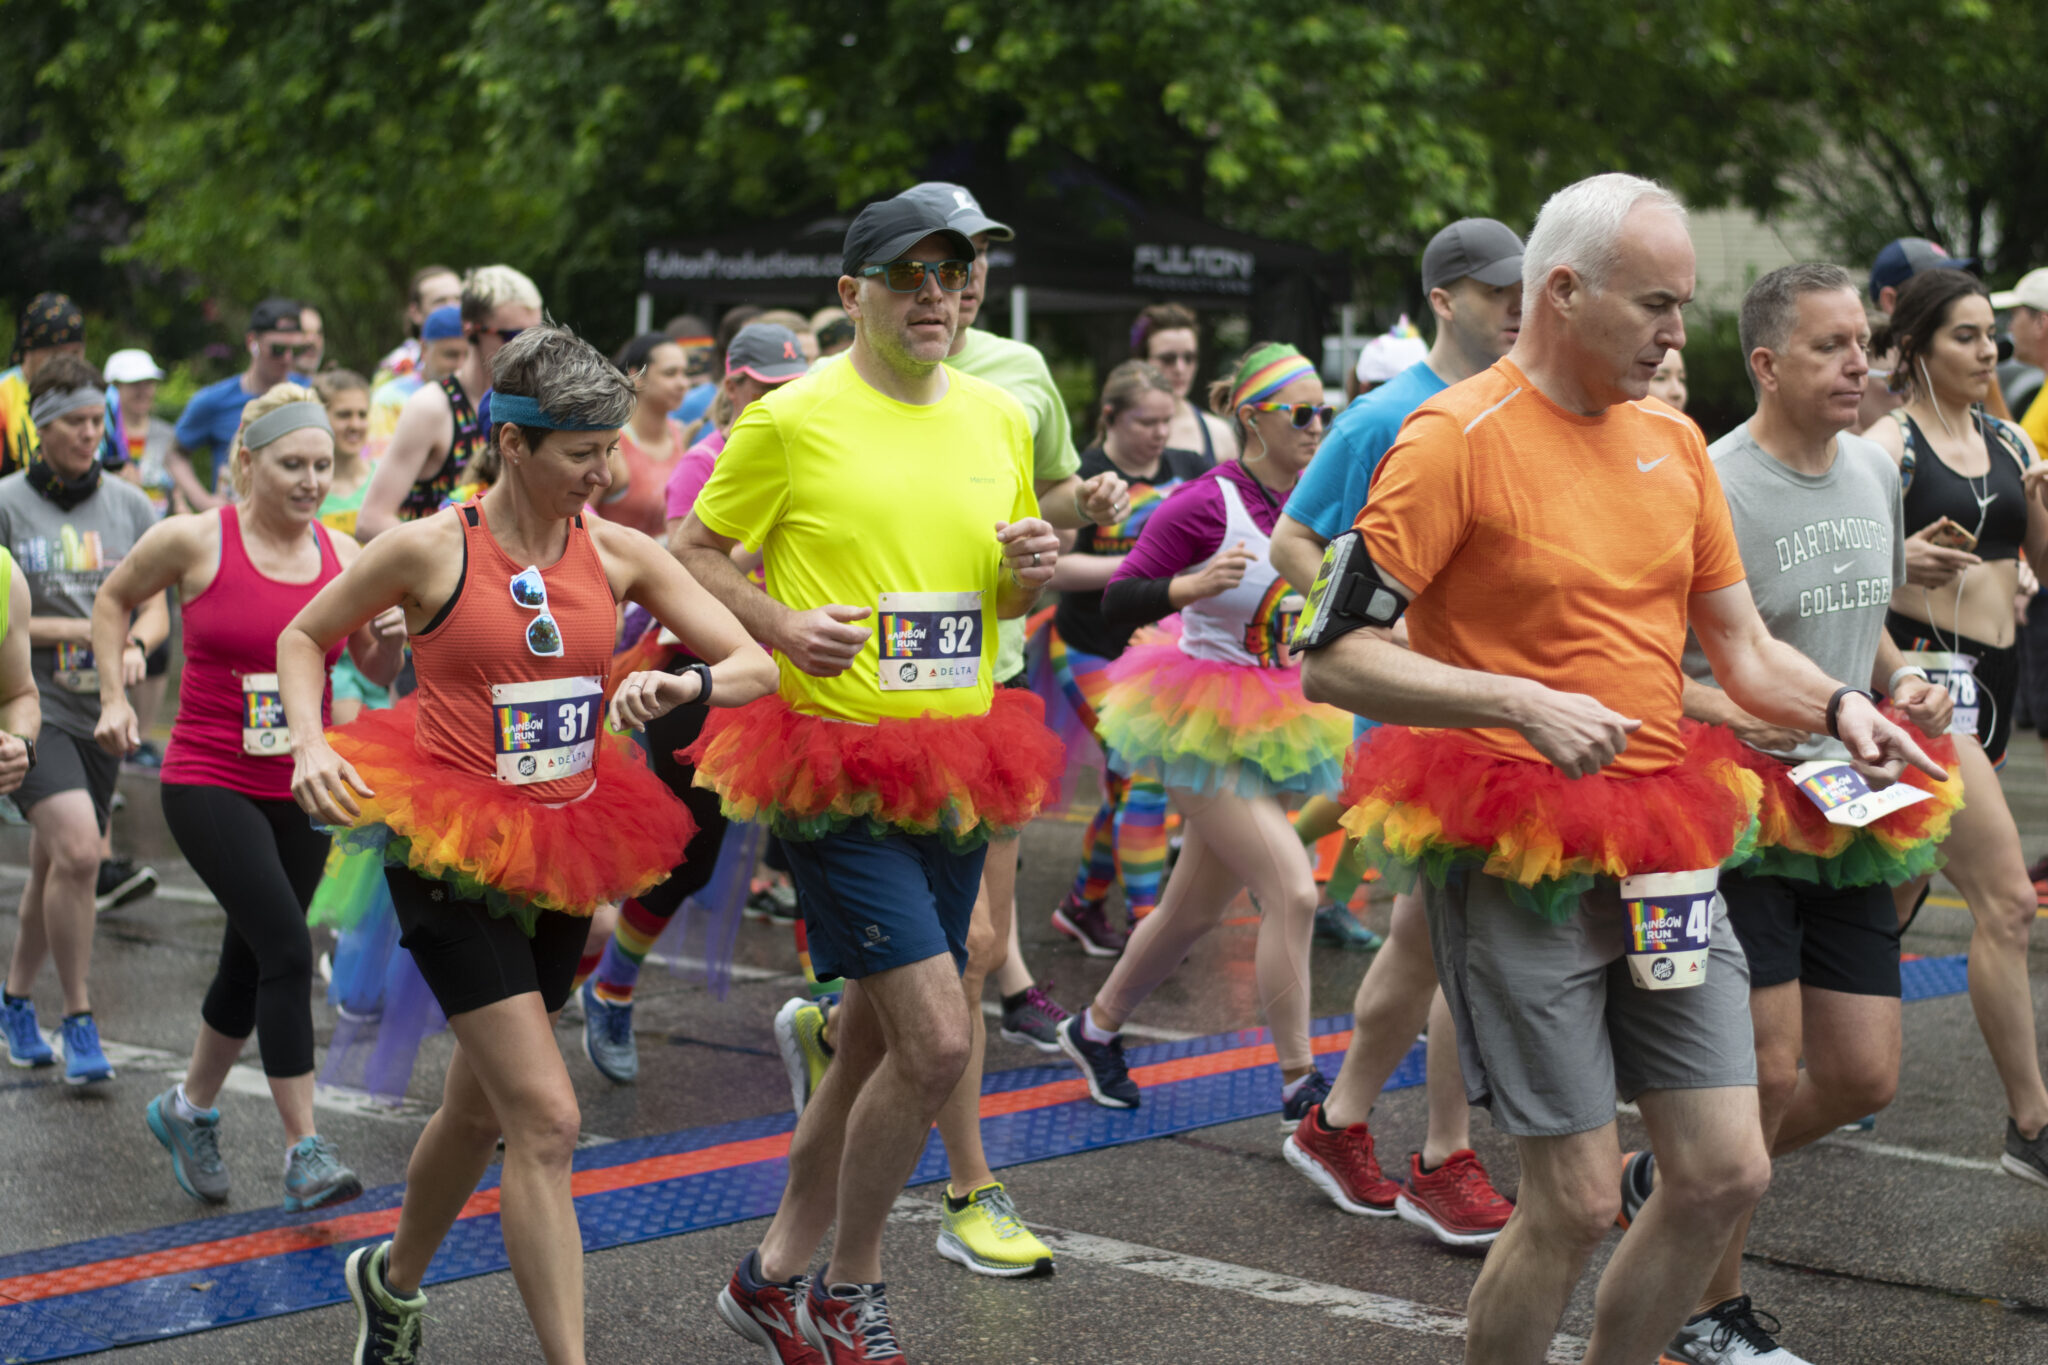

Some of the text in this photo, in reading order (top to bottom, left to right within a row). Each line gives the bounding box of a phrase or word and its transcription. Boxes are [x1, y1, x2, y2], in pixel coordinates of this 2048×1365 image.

[645, 249, 843, 279] FultonProductions.co
[1775, 517, 1890, 573] DARTMOUTH
[1800, 577, 1890, 618] COLLEGE
[887, 628, 927, 641] RAINBOW
[938, 615, 974, 654] 32
[897, 640, 917, 648] RUN
[940, 666, 973, 676] DELTA
[503, 719, 543, 734] RAINBOW
[558, 701, 590, 742] 31
[514, 731, 535, 741] RUN
[557, 751, 586, 765] DELTA
[1634, 915, 1682, 932] RAINBOW
[1646, 930, 1671, 940] RUN
